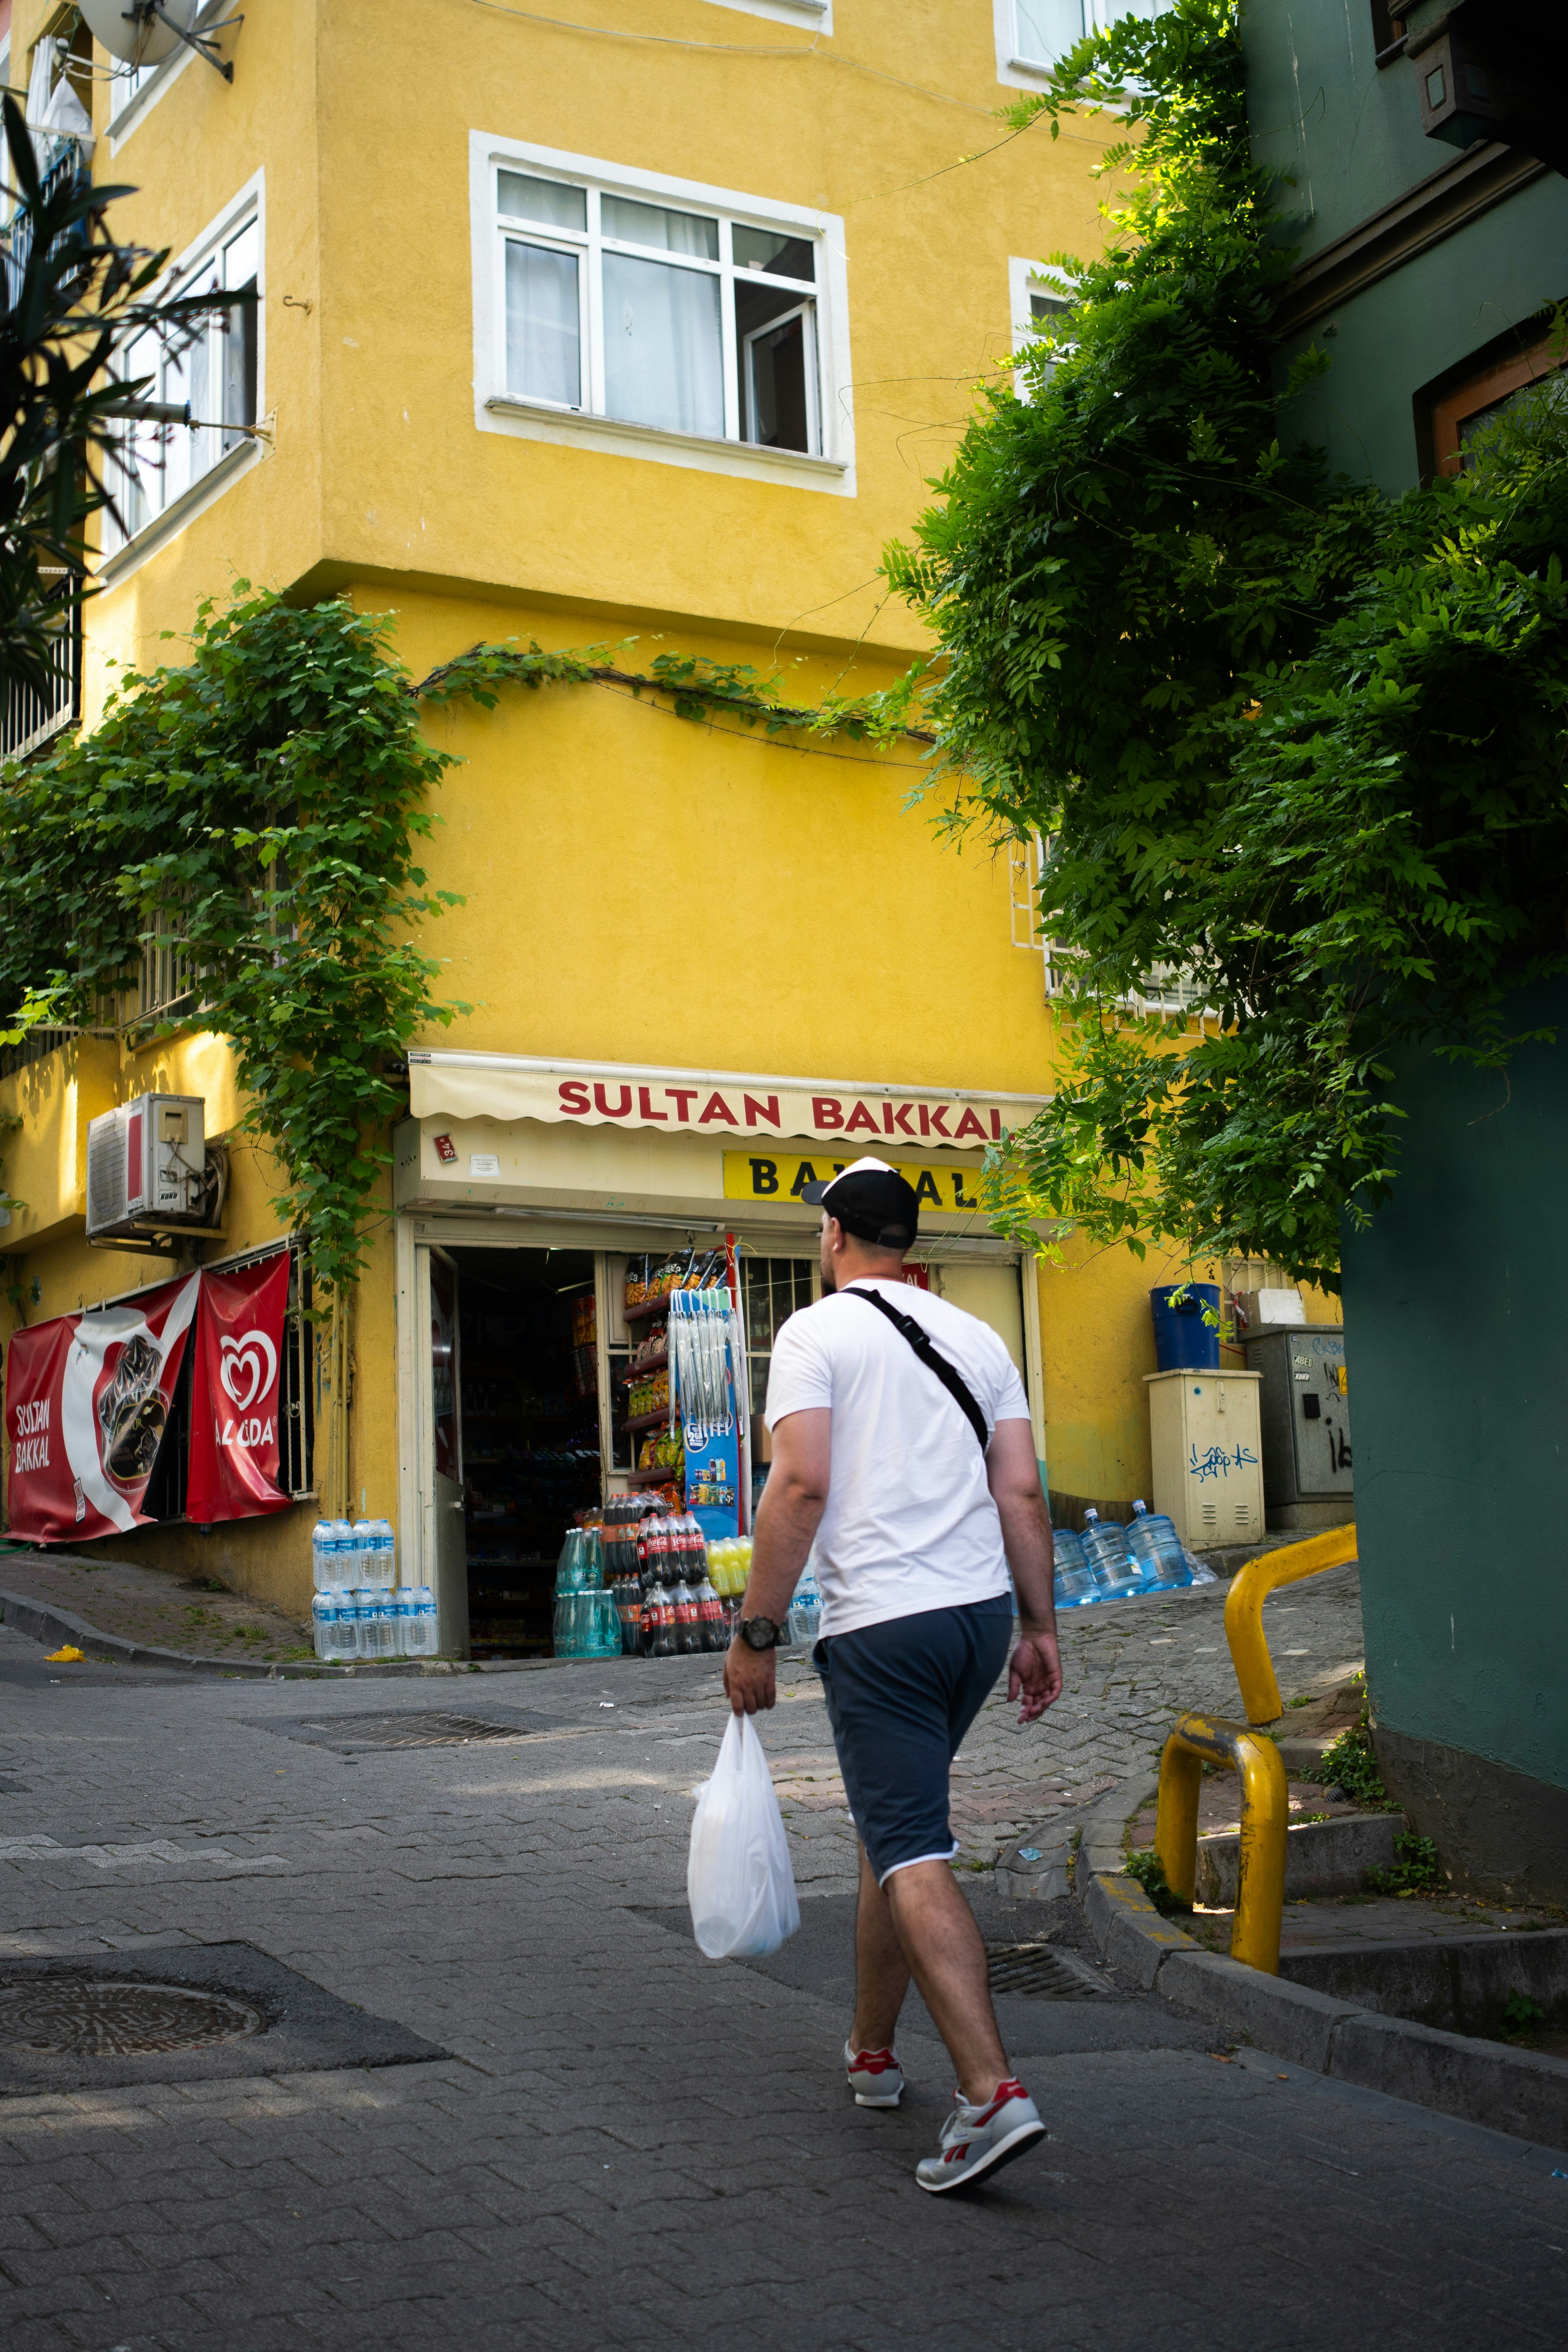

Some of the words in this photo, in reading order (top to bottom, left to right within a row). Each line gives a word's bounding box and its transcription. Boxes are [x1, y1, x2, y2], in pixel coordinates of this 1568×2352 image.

[559, 1081, 781, 1128] SULTAN
[812, 1097, 1016, 1141] BAKKAL
[749, 1158, 977, 1208] BAAL
[16, 1397, 50, 1437] SULTAN
[15, 1435, 49, 1474] BAKKAL
